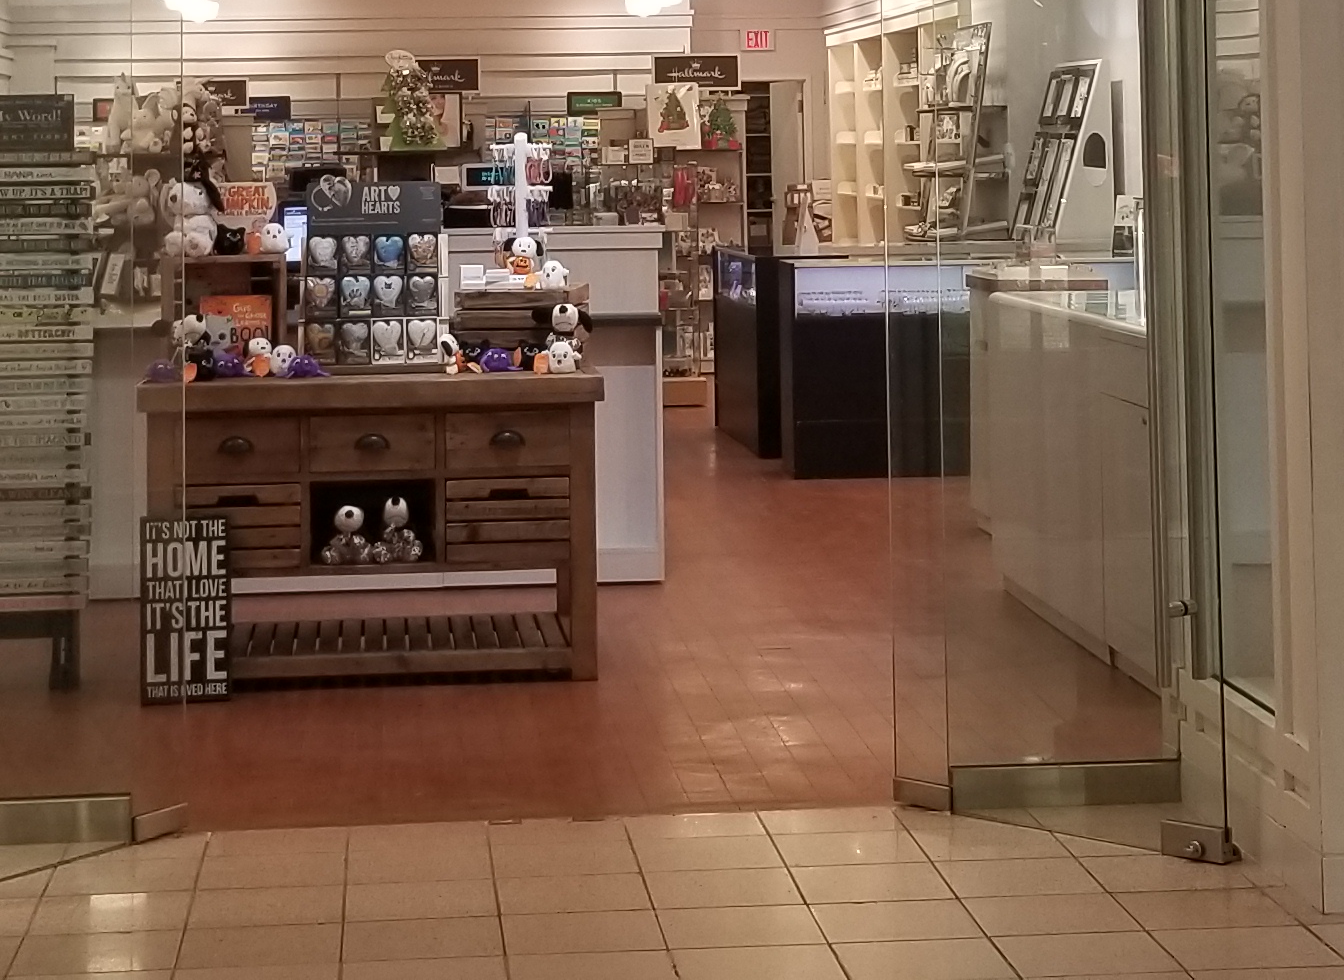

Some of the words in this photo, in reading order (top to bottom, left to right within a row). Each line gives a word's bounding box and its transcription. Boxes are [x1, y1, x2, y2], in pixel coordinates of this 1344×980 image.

[746, 30, 769, 49] EXIT
[666, 66, 727, 83] Hallmark
[18, 109, 61, 122] Word!
[50, 187, 56, 196] A
[228, 185, 267, 197] GREAT
[362, 185, 387, 202] ART
[361, 201, 401, 214] HEARTS
[146, 522, 170, 540] IT'S
[173, 520, 198, 539] NOT
[200, 519, 226, 537] THE
[146, 540, 226, 578] HOME
[147, 580, 183, 600] THAT
[192, 578, 227, 598] LOVE
[146, 601, 184, 630] IT'S
[187, 600, 227, 628] THE
[146, 629, 227, 683] LIFE
[147, 685, 168, 698] THAT
[170, 684, 179, 697] IS
[205, 682, 227, 695] HERE
